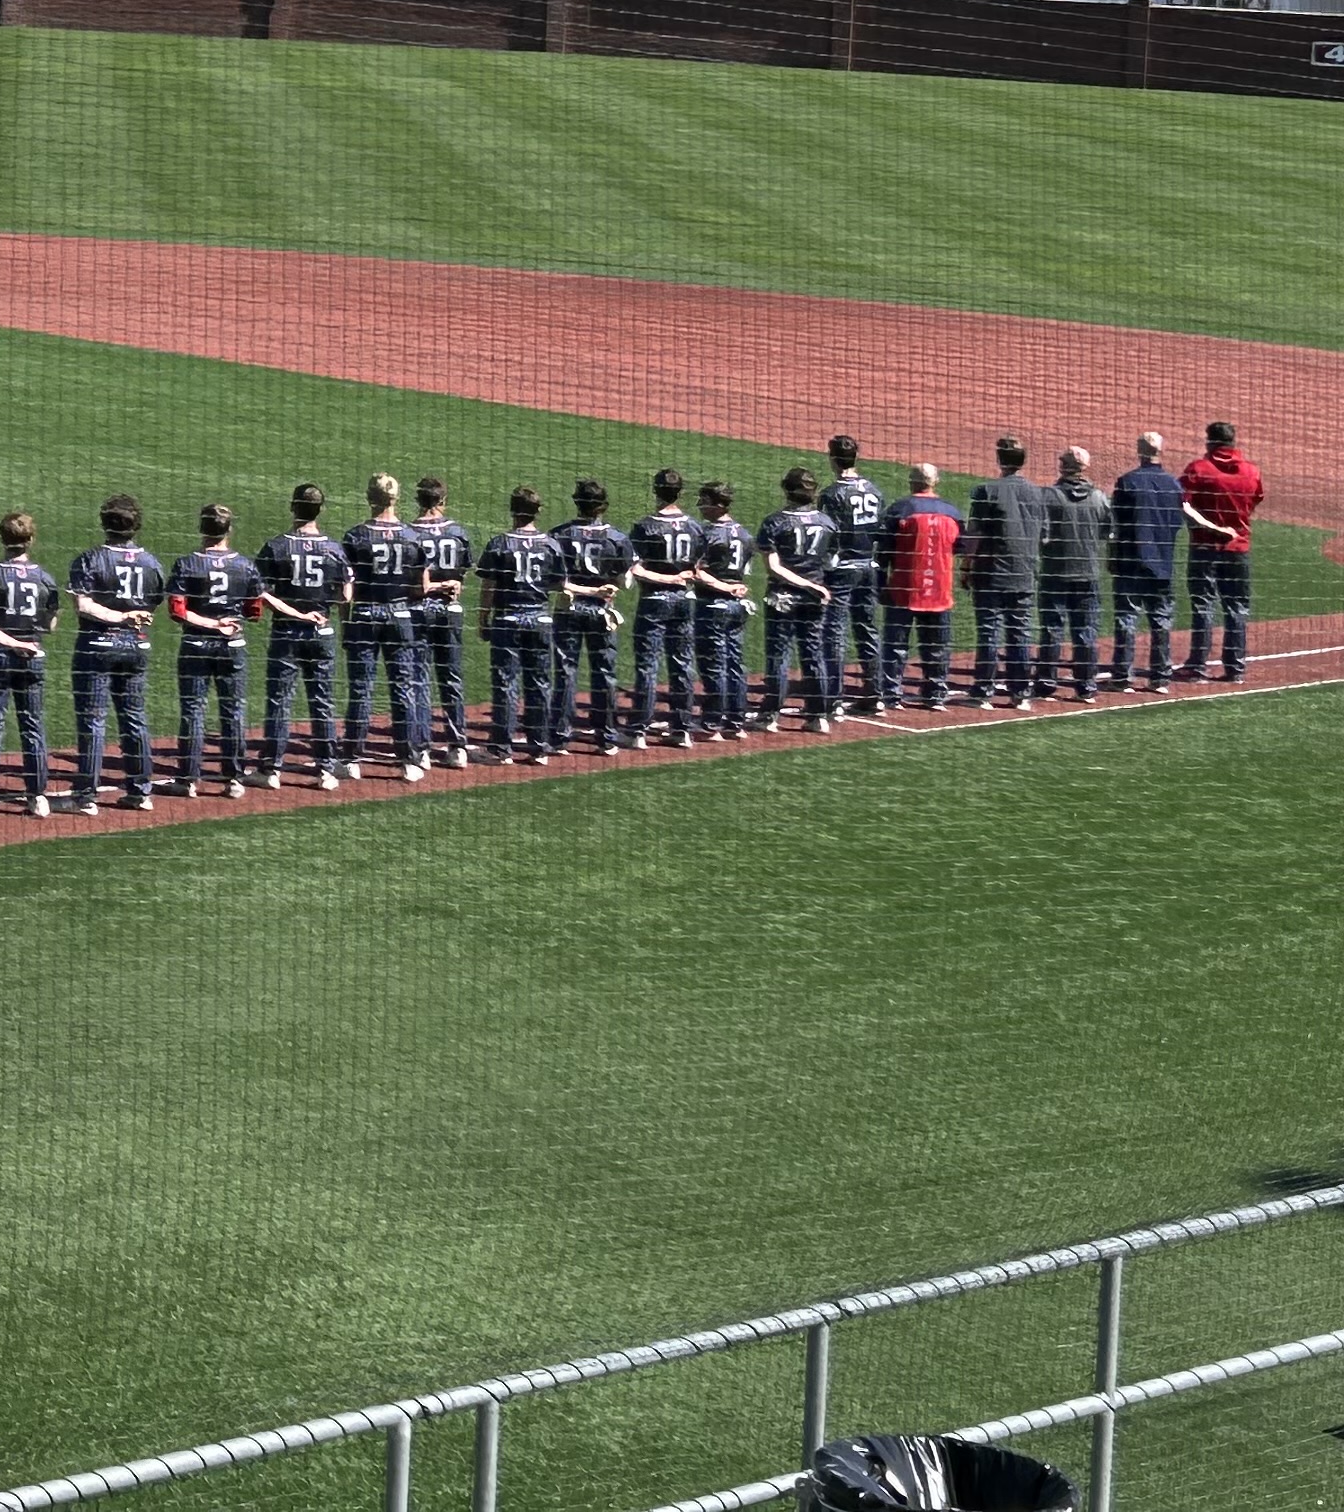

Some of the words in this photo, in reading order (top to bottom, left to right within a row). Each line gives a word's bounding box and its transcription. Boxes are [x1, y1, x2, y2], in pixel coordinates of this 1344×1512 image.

[849, 493, 880, 526] 25
[793, 526, 824, 556] 17
[290, 553, 325, 588] 15
[371, 542, 404, 576] 21
[5, 581, 39, 617] 13
[115, 566, 145, 601] 31
[208, 570, 229, 605] 2
